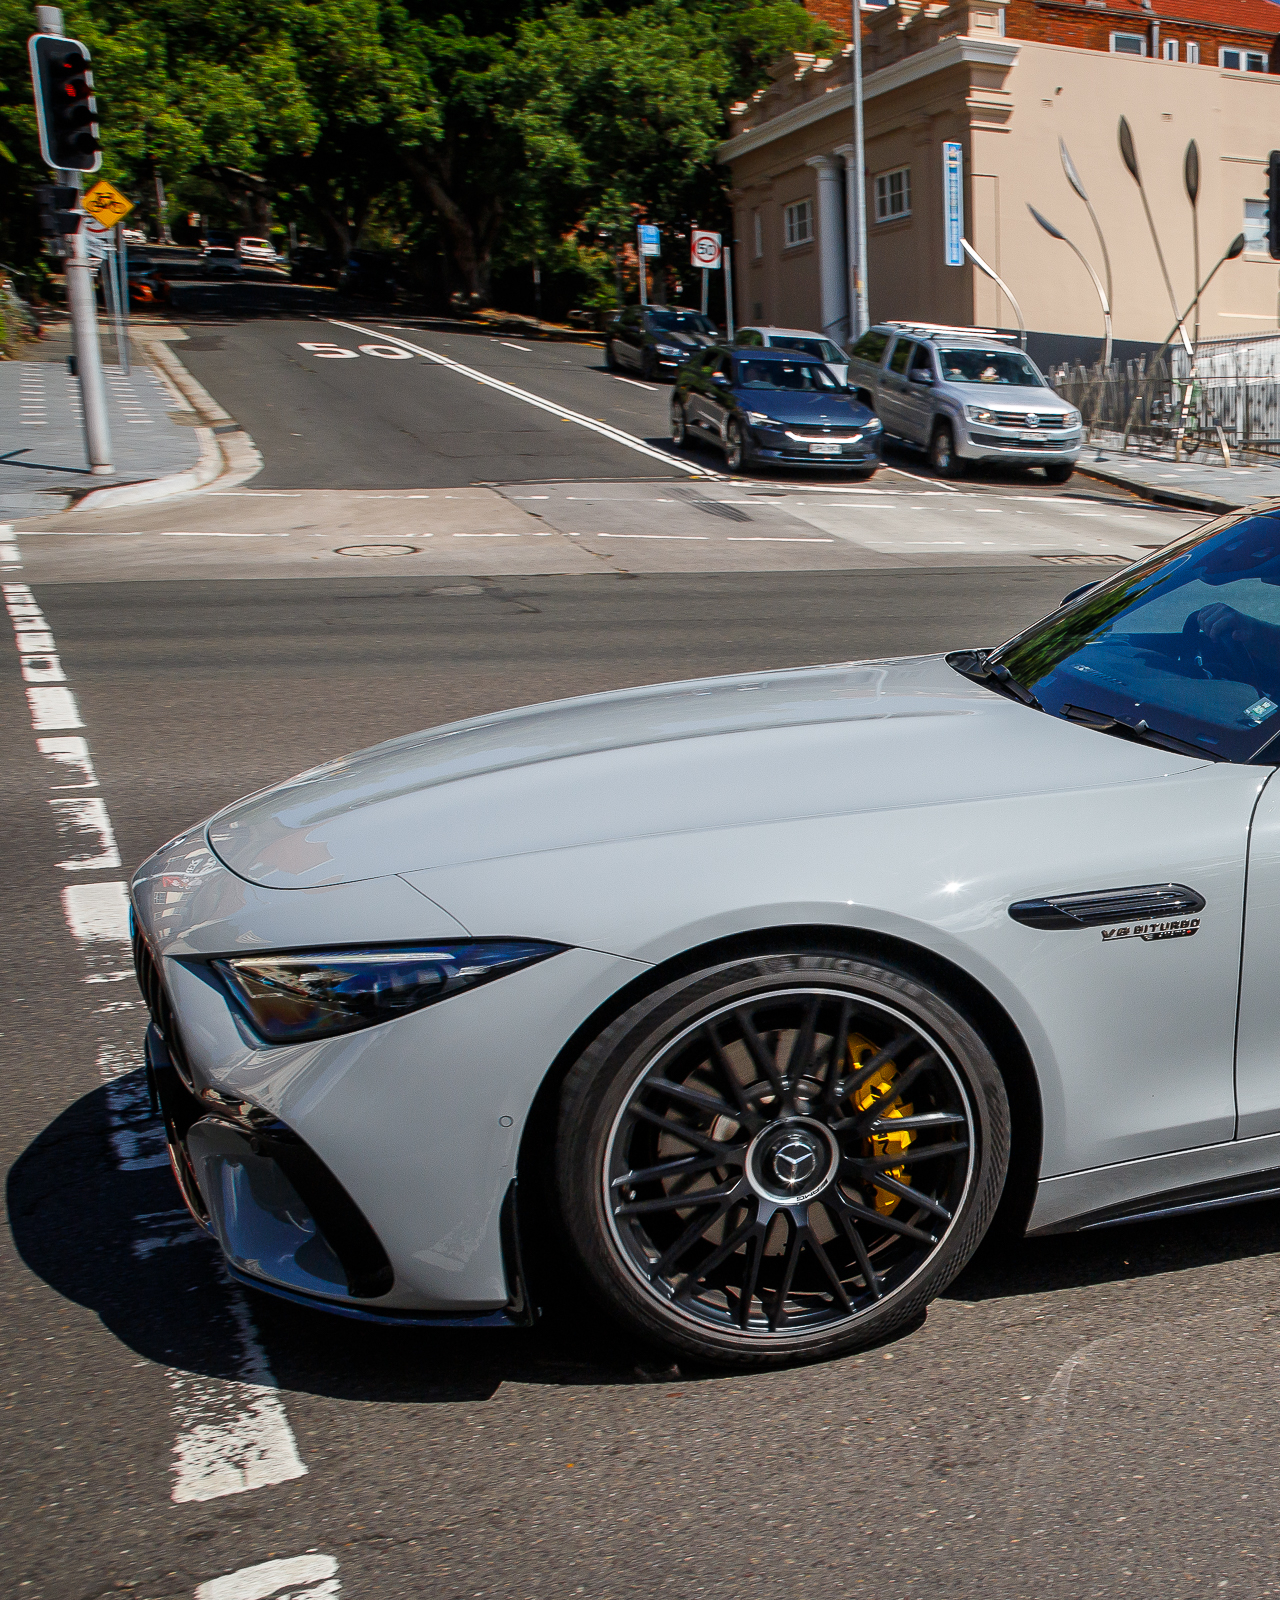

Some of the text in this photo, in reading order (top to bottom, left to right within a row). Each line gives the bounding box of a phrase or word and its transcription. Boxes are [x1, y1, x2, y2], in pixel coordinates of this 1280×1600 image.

[697, 242, 717, 255] 50
[296, 342, 415, 360] 50
[1101, 926, 1130, 939] V8
[1134, 917, 1200, 934] BITURBO
